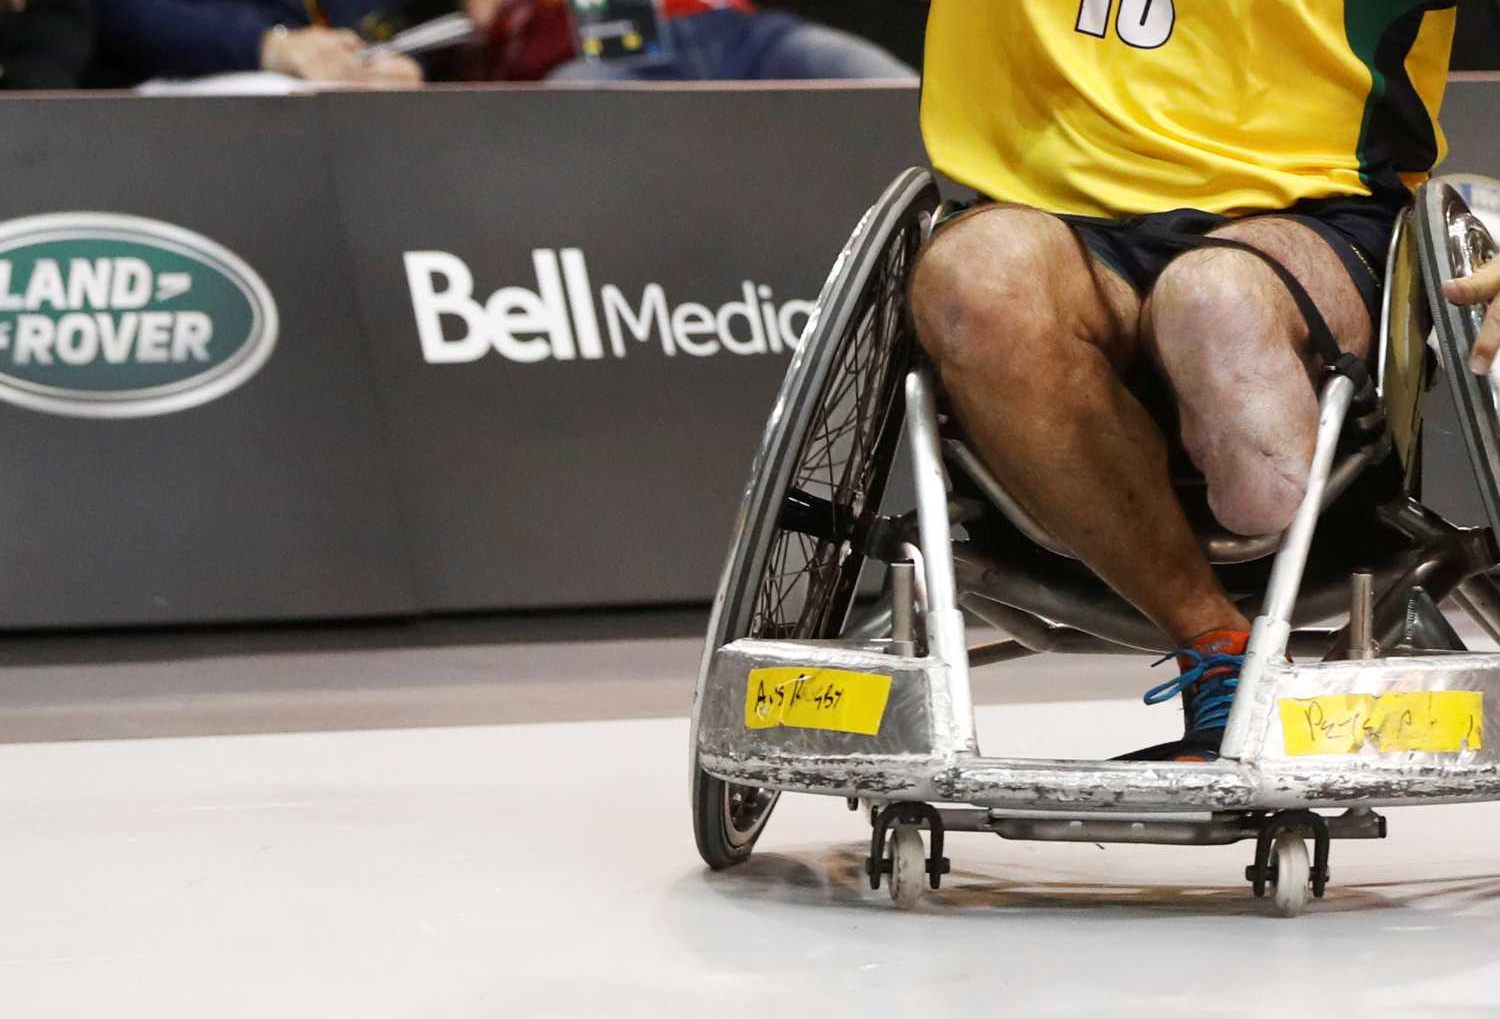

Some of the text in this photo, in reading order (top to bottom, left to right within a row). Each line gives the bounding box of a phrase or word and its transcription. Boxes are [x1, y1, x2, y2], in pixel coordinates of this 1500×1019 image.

[0, 256, 153, 311] LAND
[403, 247, 604, 365] Bell
[13, 310, 213, 366] ROVER
